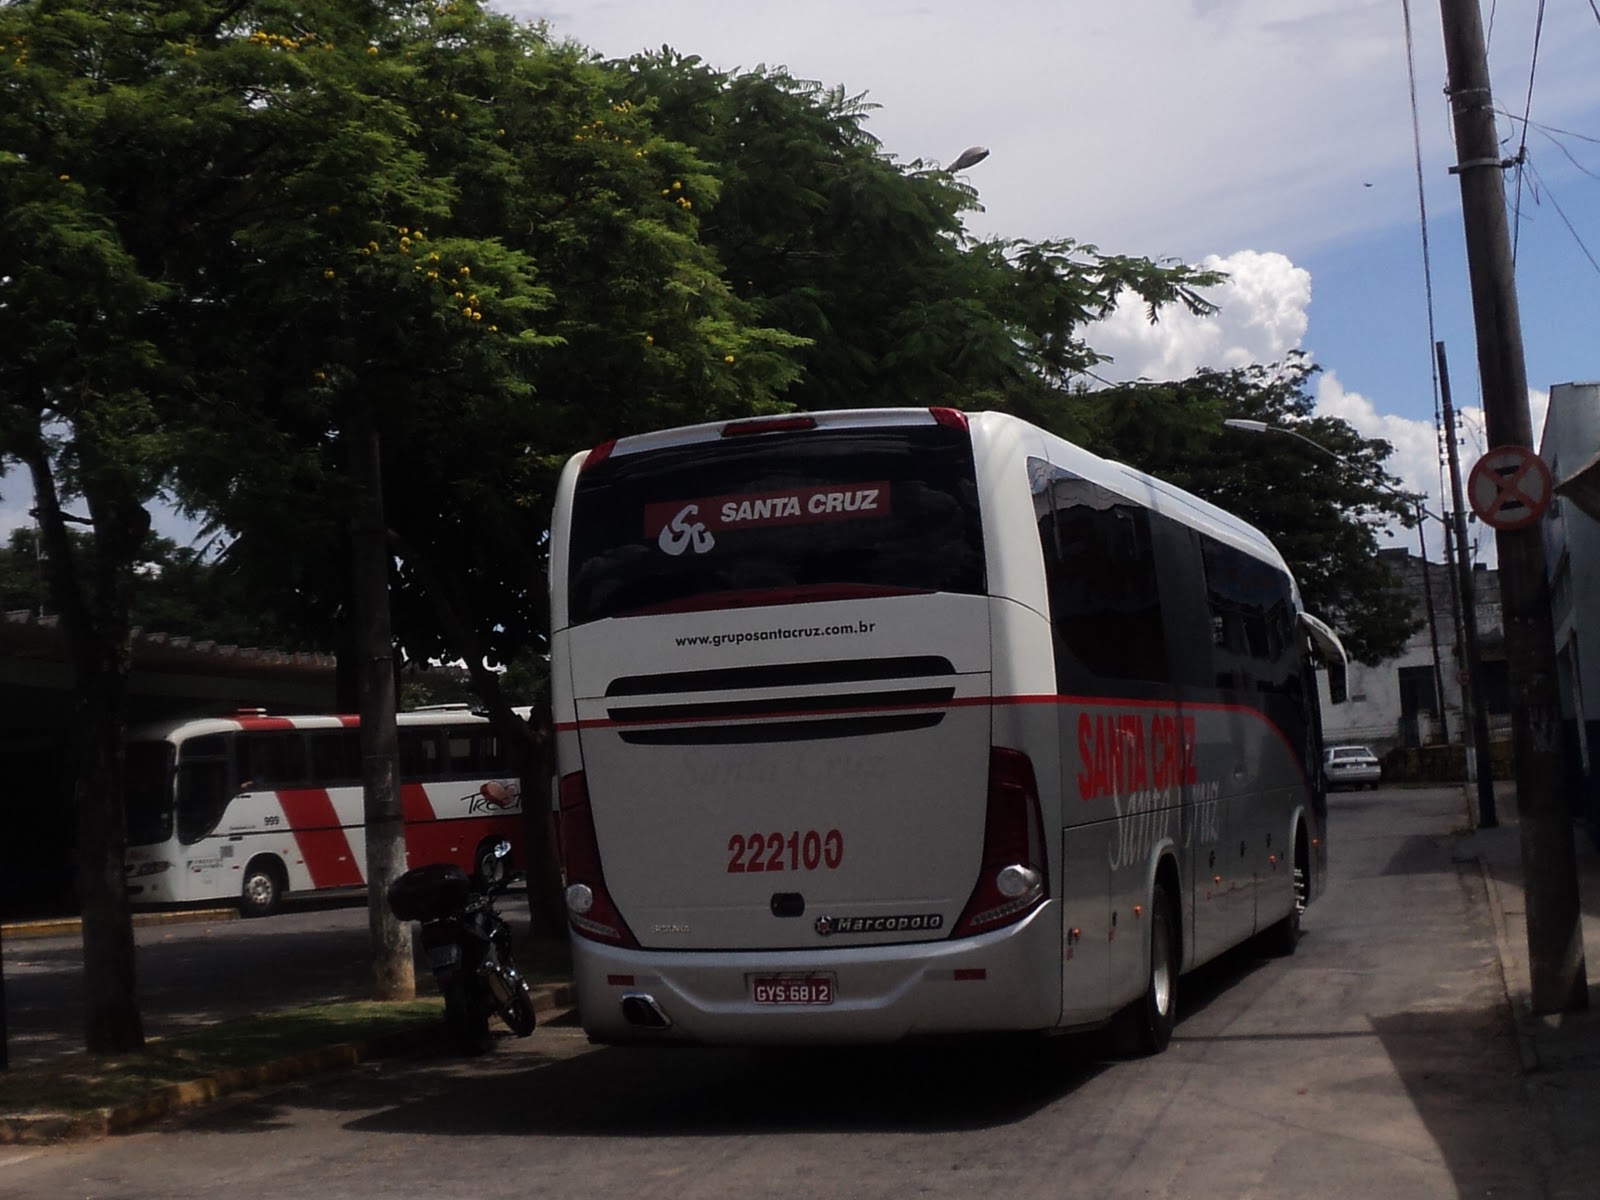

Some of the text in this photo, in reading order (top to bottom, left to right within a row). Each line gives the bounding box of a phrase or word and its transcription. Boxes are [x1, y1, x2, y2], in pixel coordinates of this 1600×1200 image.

[720, 489, 879, 522] SANTA CRUZ
[675, 620, 876, 647] www.gruposantacruz.com.br
[1077, 711, 1198, 801] SANTA CRUZ
[264, 816, 279, 826] 999
[727, 829, 844, 873] 222100
[837, 915, 941, 931] Marcopolo
